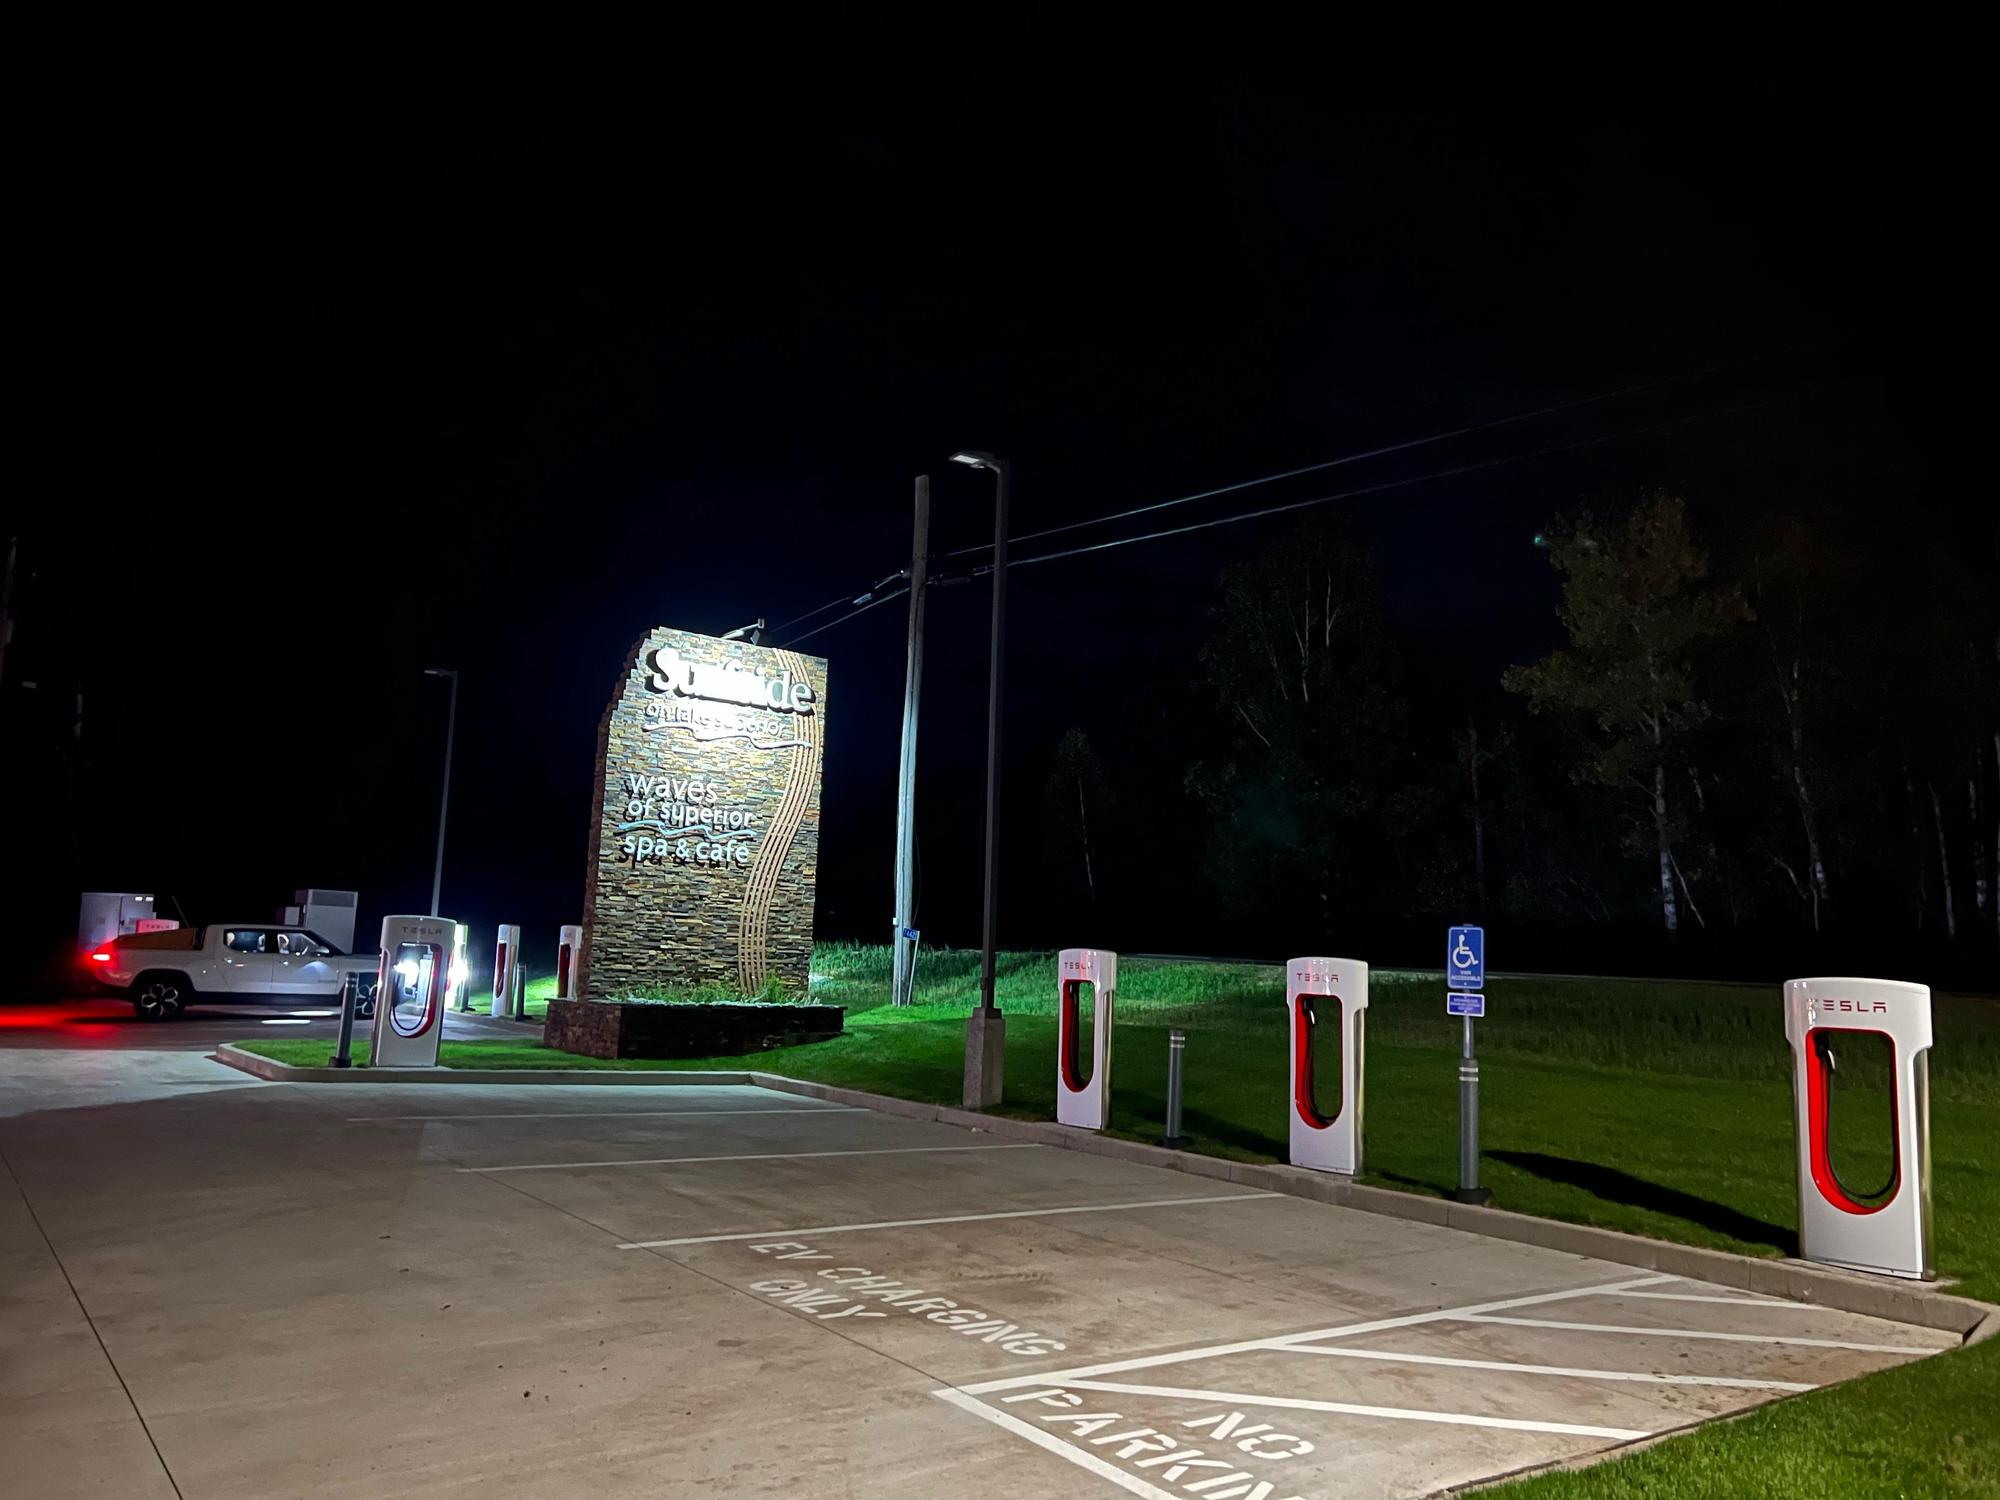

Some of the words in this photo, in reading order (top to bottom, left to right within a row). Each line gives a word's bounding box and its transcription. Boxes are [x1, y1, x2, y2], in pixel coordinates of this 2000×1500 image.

[653, 648, 811, 711] Sude
[629, 774, 719, 803] waves
[628, 797, 655, 817] of
[660, 802, 752, 828] superior
[623, 834, 668, 861] spa
[675, 838, 690, 860] &
[402, 926, 442, 935] TESLA
[748, 1242, 834, 1259] EV
[817, 1267, 1067, 1355] CHARGING
[750, 1279, 888, 1319] ONLY
[1182, 1411, 1315, 1460] NO
